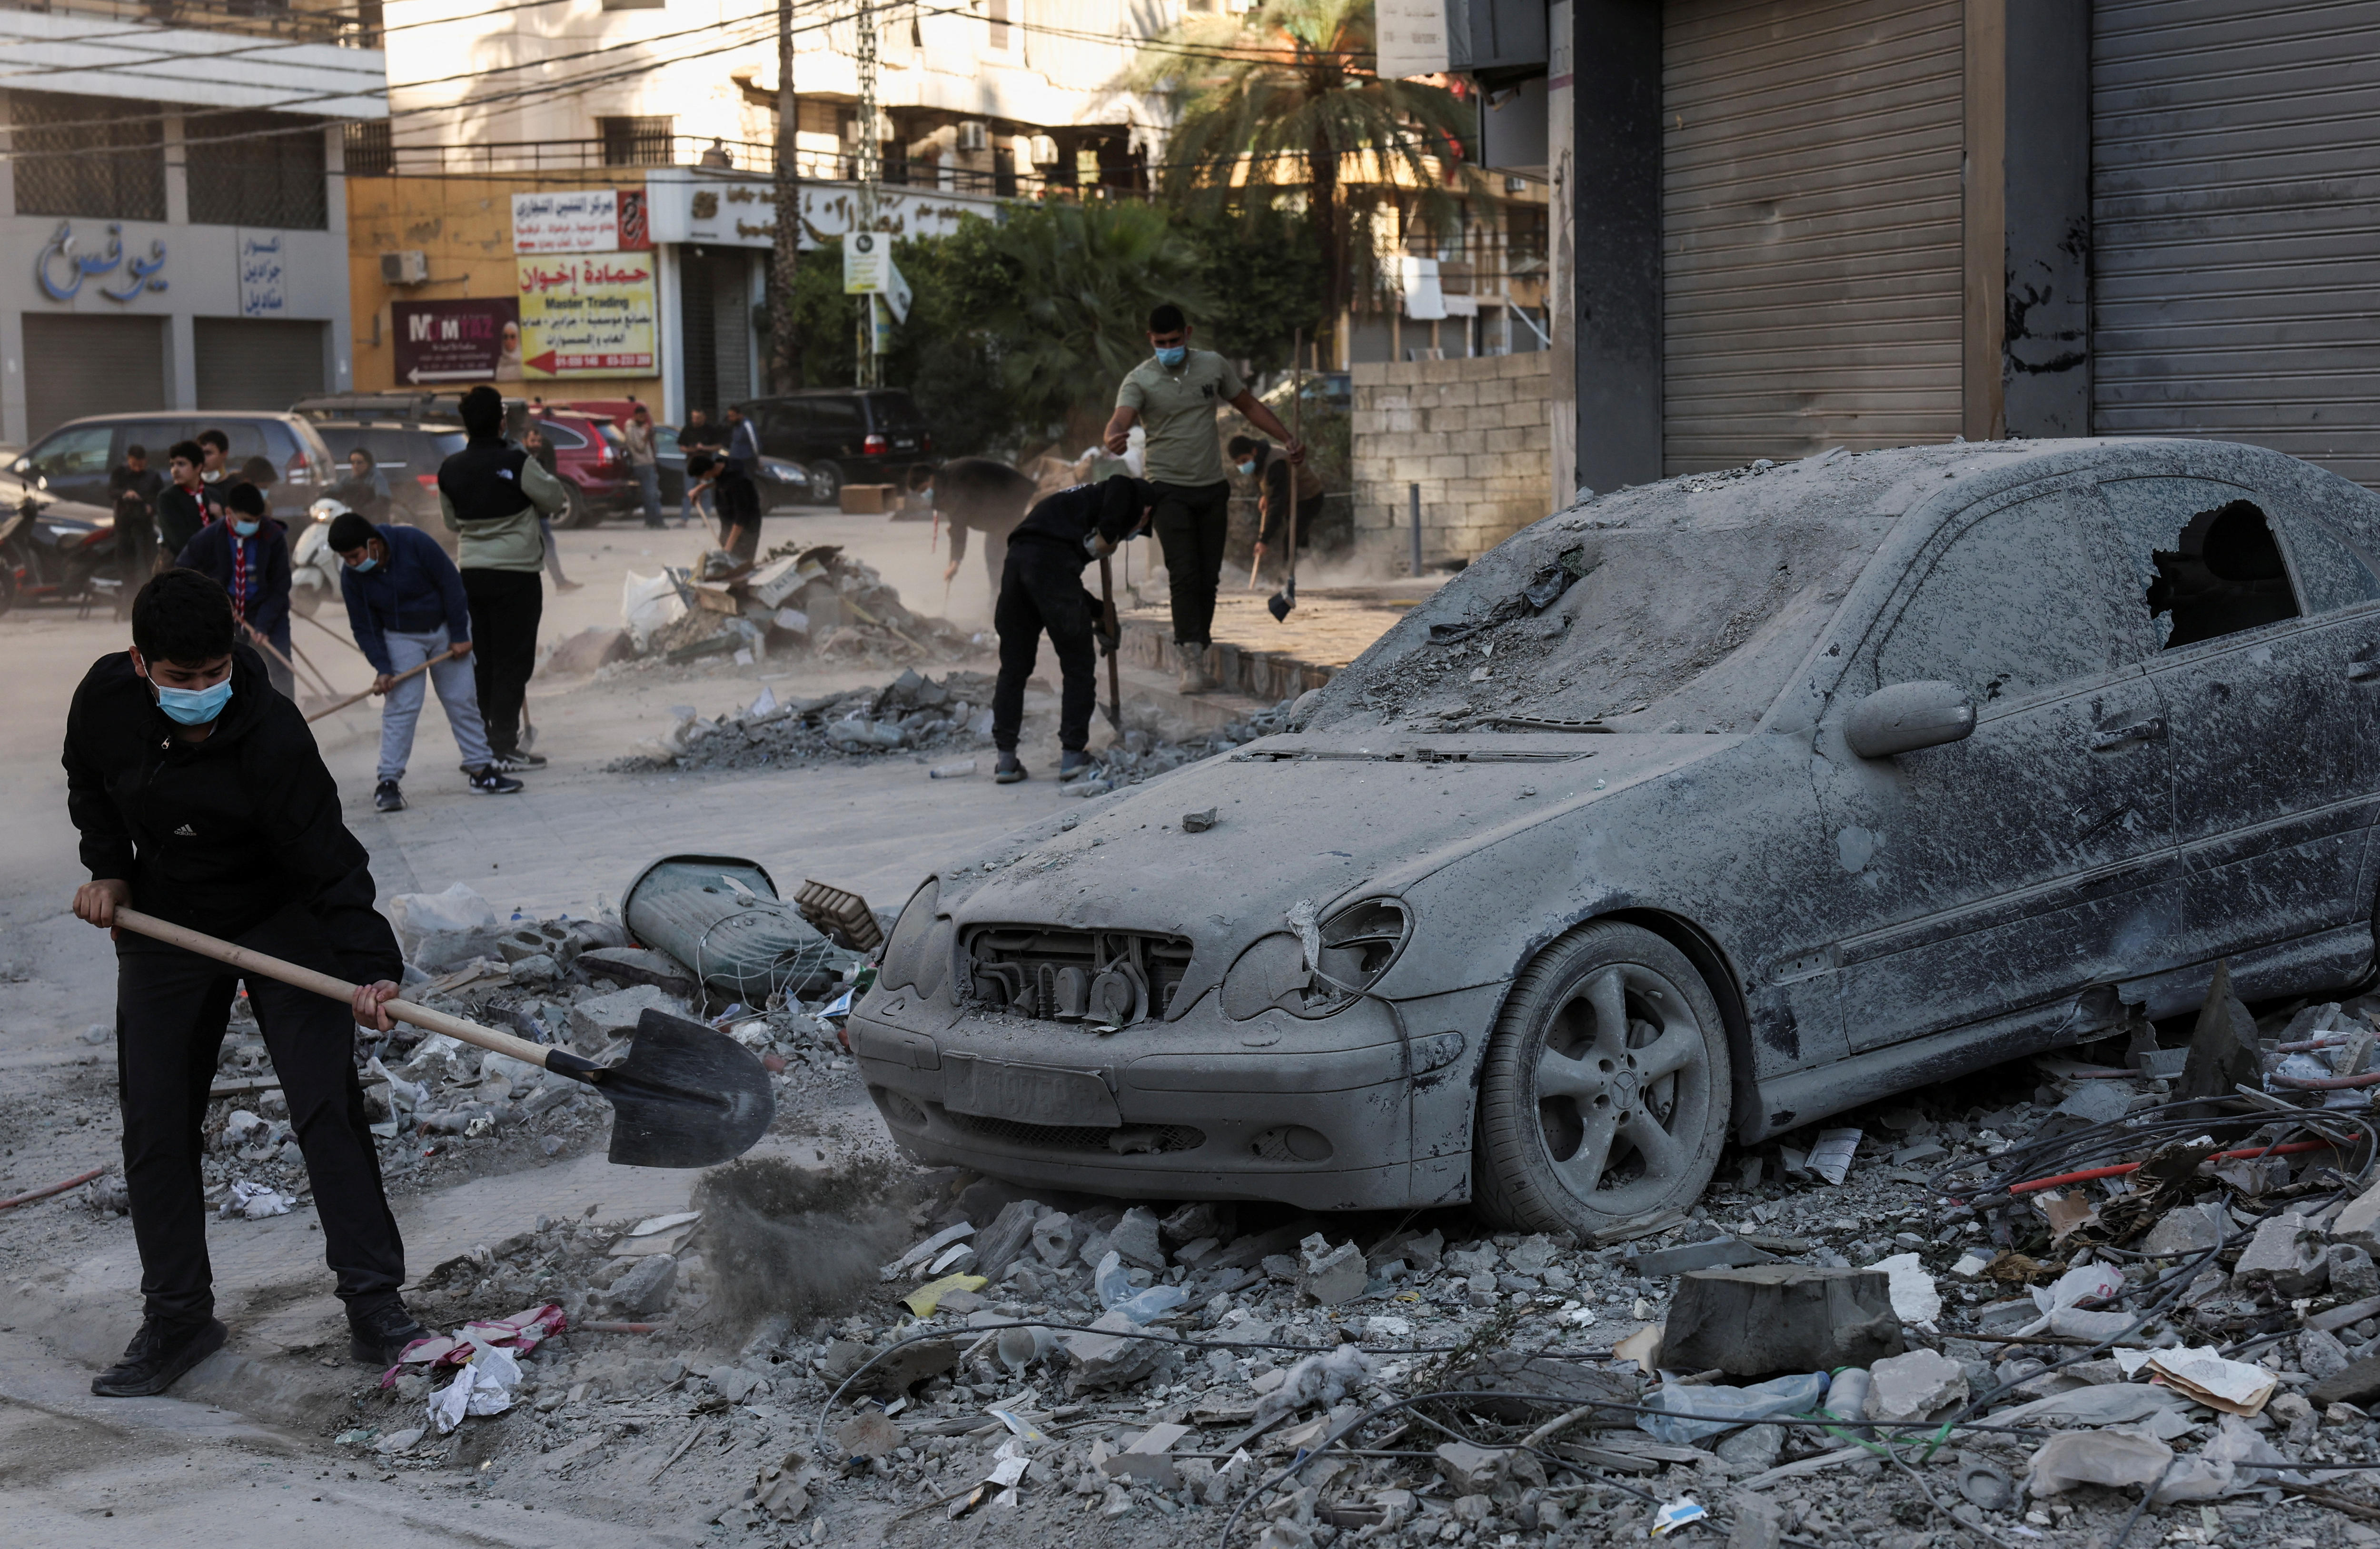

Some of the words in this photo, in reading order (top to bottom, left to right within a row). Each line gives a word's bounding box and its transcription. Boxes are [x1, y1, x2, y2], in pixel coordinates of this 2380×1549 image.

[38, 222, 169, 301] يونس
[584, 259, 650, 284] حمادة
[520, 263, 577, 295] إخوان
[545, 297, 584, 309] Master
[586, 296, 629, 310] Trading
[408, 313, 494, 342] MUMTAZ
